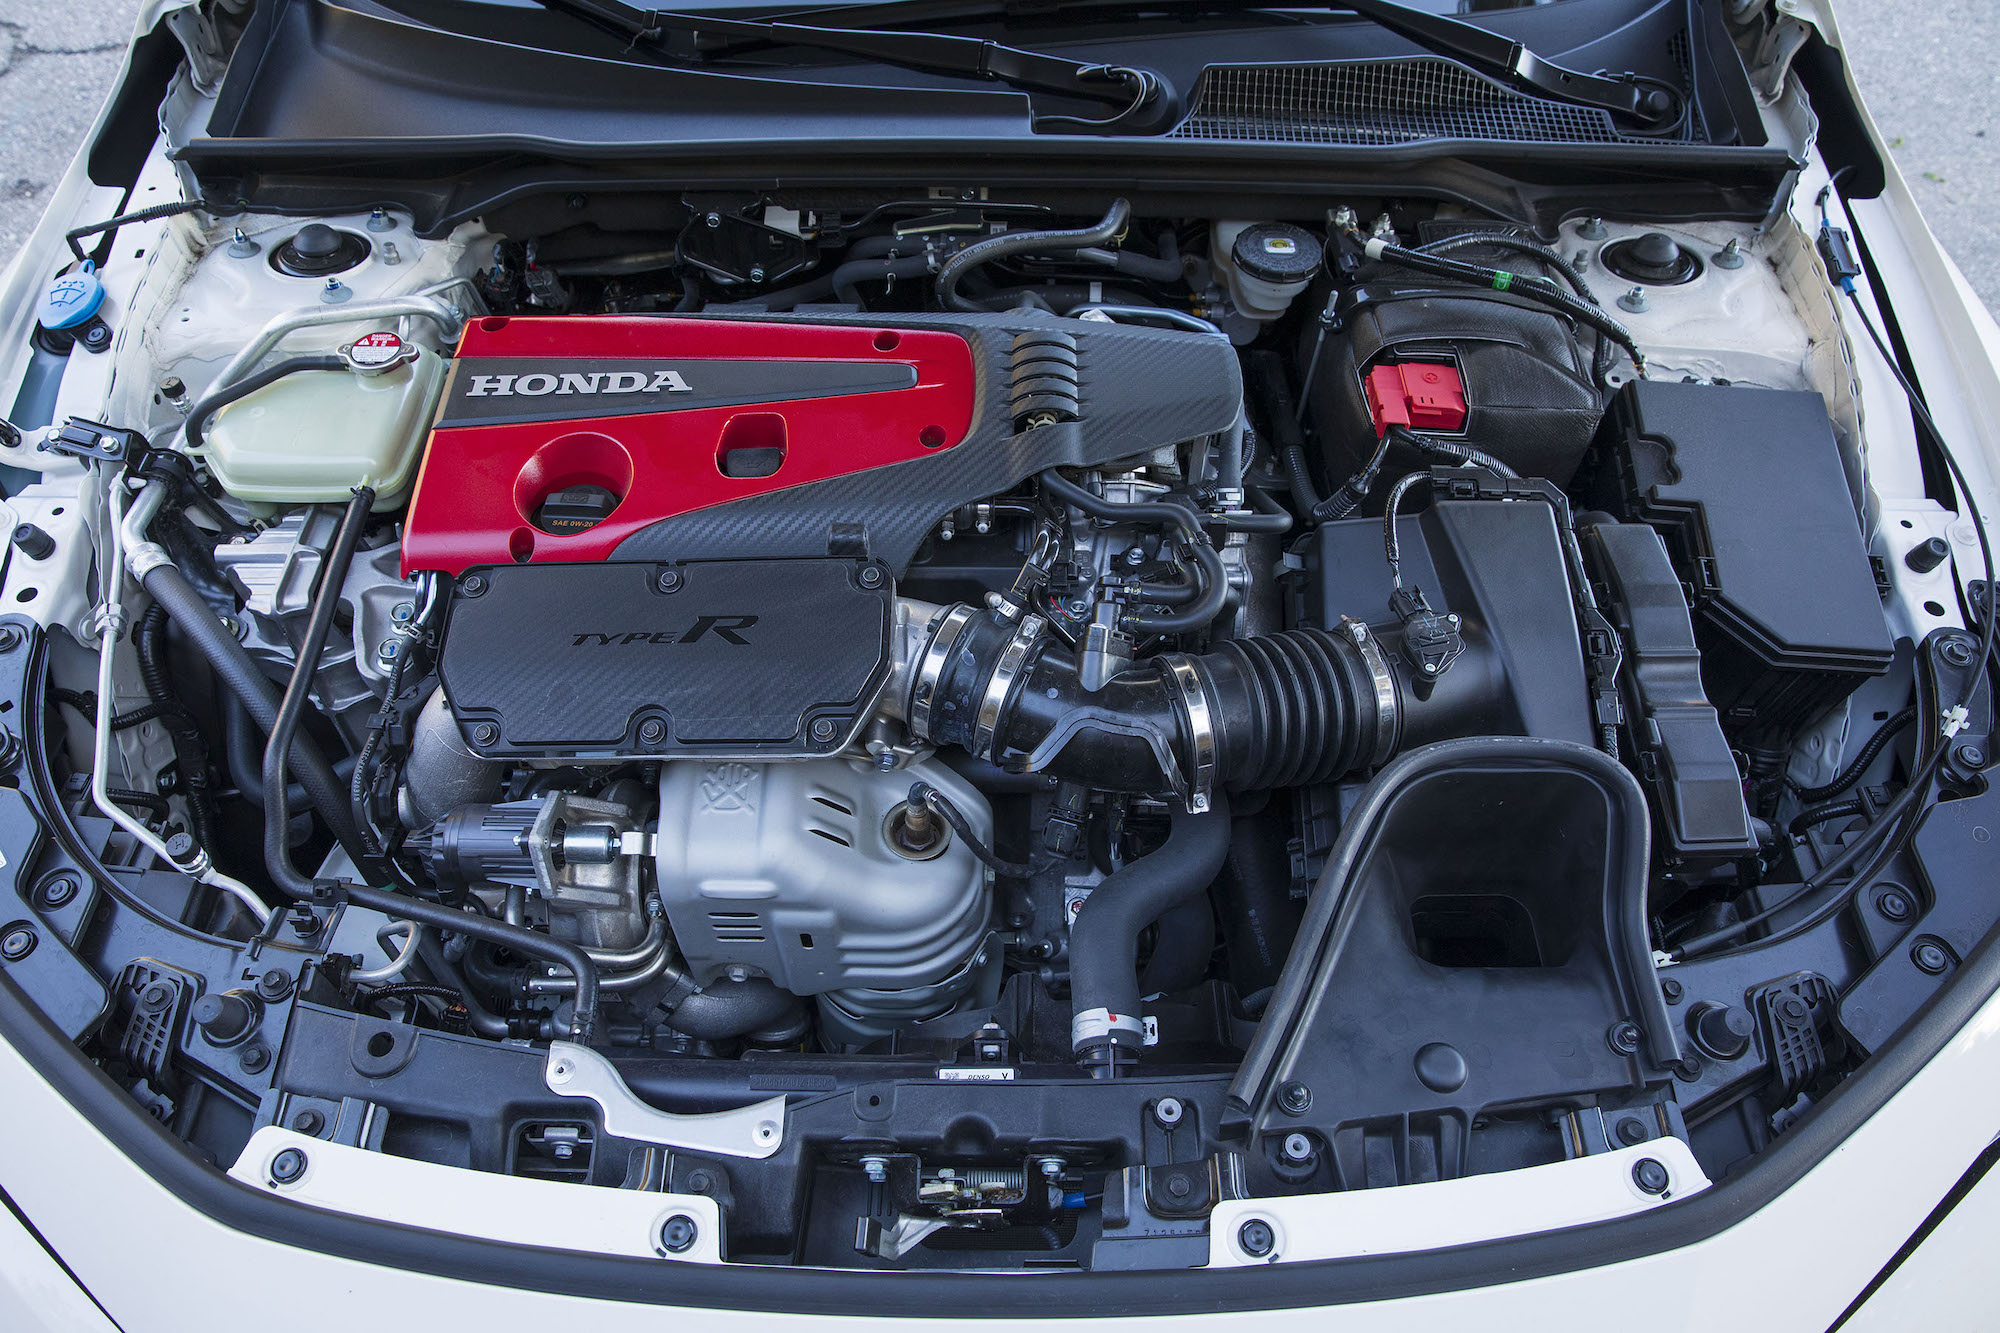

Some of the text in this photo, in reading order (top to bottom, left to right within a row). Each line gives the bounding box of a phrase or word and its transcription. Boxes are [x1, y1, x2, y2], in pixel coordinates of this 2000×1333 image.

[466, 370, 693, 397] HONDA
[571, 615, 760, 646] TYPE R
